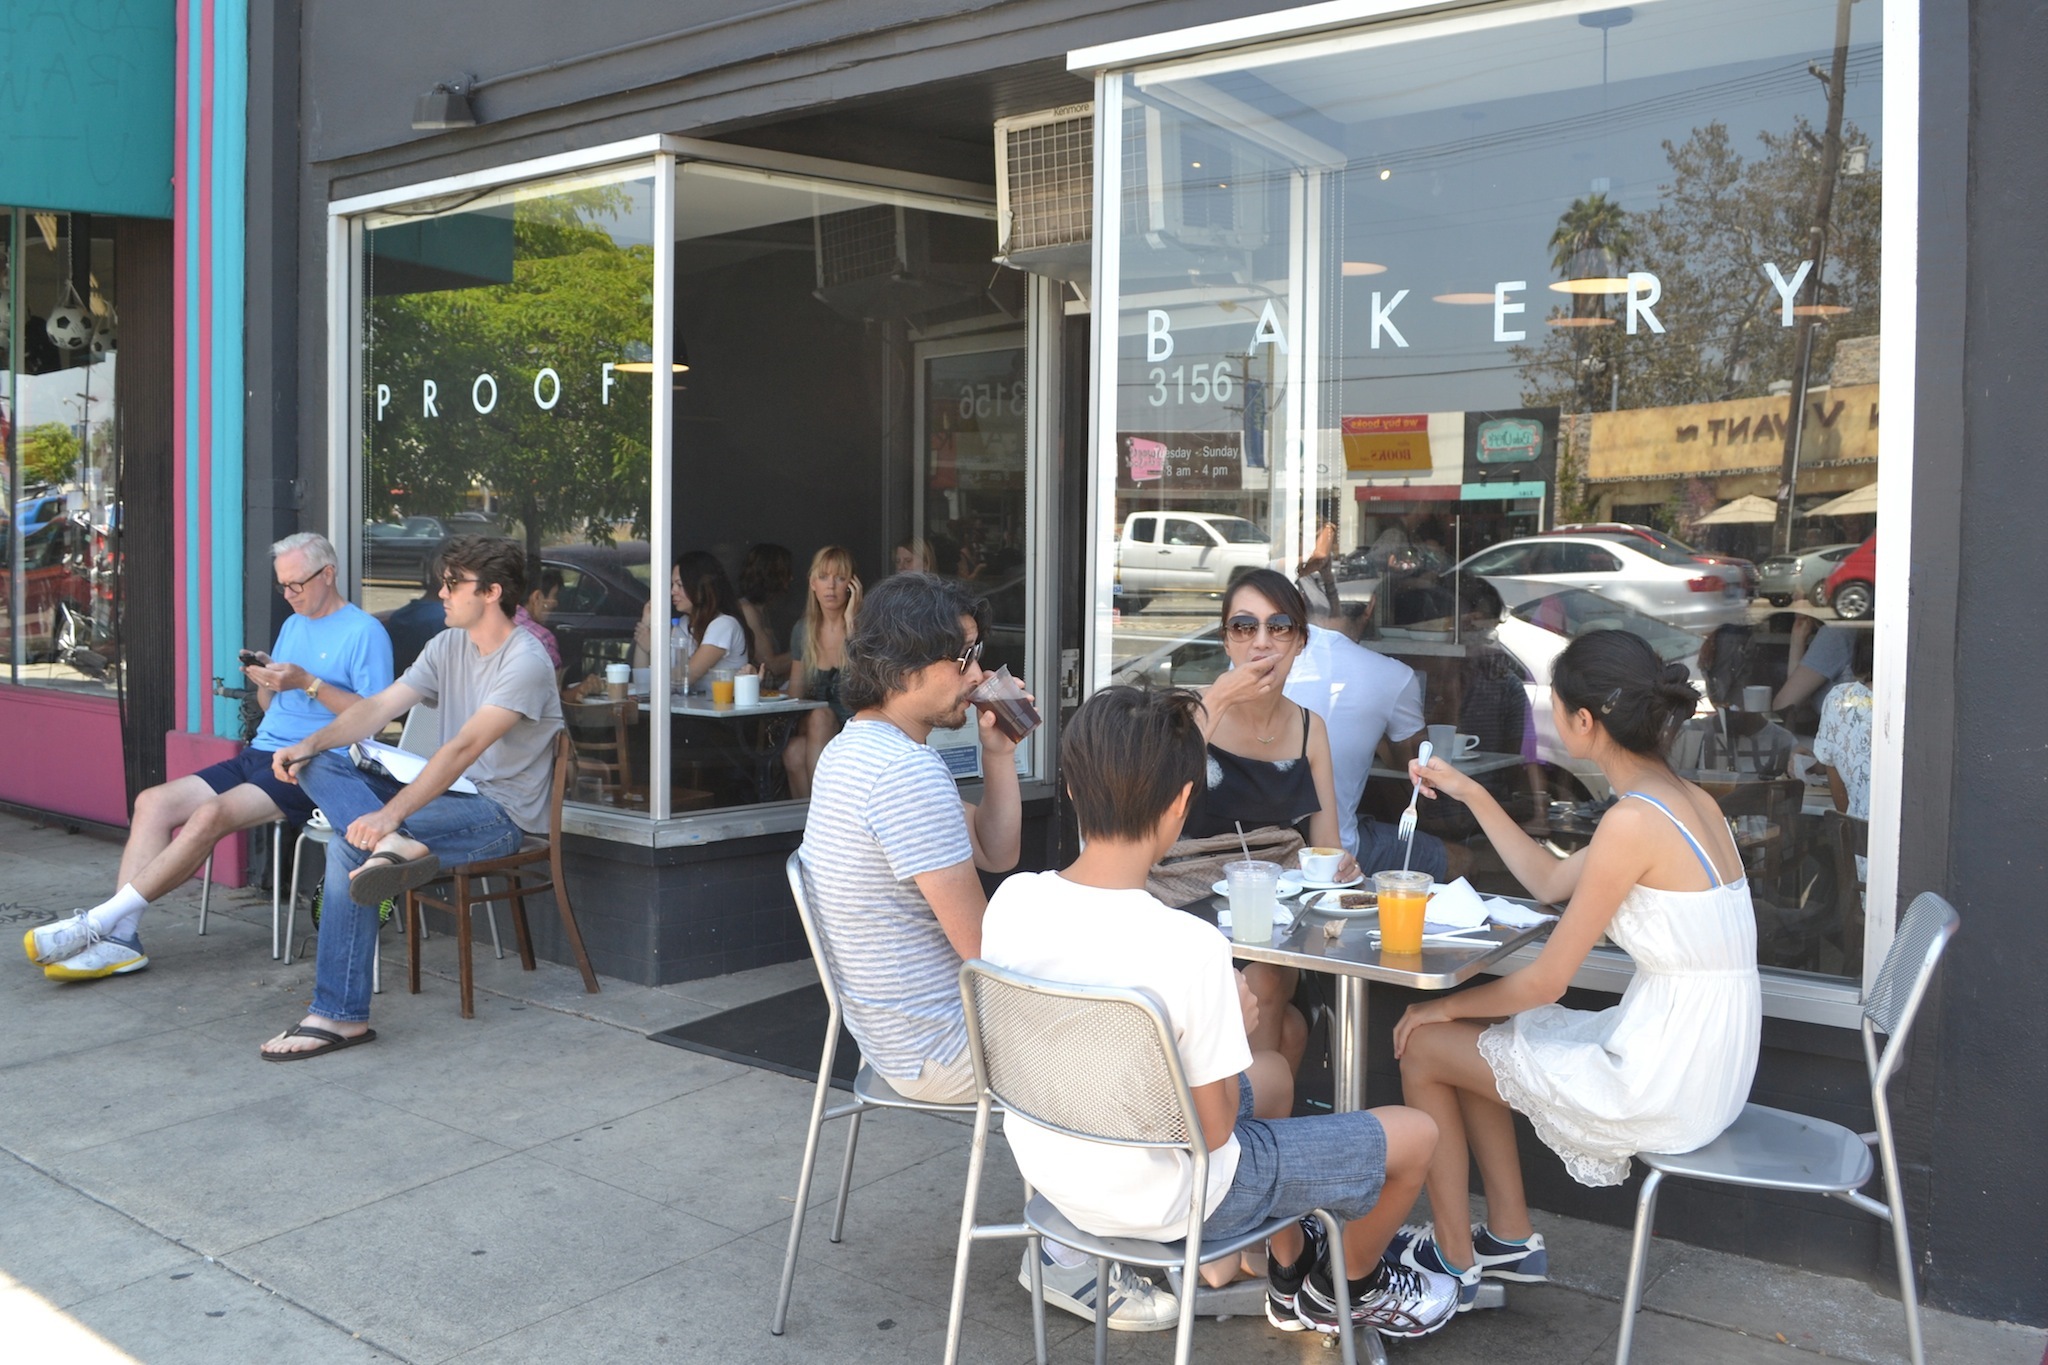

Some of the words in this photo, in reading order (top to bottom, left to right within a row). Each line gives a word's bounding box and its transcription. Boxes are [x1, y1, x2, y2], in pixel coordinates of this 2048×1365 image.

[1054, 103, 1090, 116] Kenmore
[1147, 259, 1815, 363] BAKERY
[377, 362, 614, 422] PROOF
[1148, 361, 1233, 407] 3156
[1153, 446, 1191, 460] Tuesday
[1203, 445, 1238, 459] Sunday
[1166, 465, 1173, 476] 8
[1176, 467, 1191, 476] am
[1202, 464, 1209, 475] 4
[1212, 465, 1228, 478] pm
